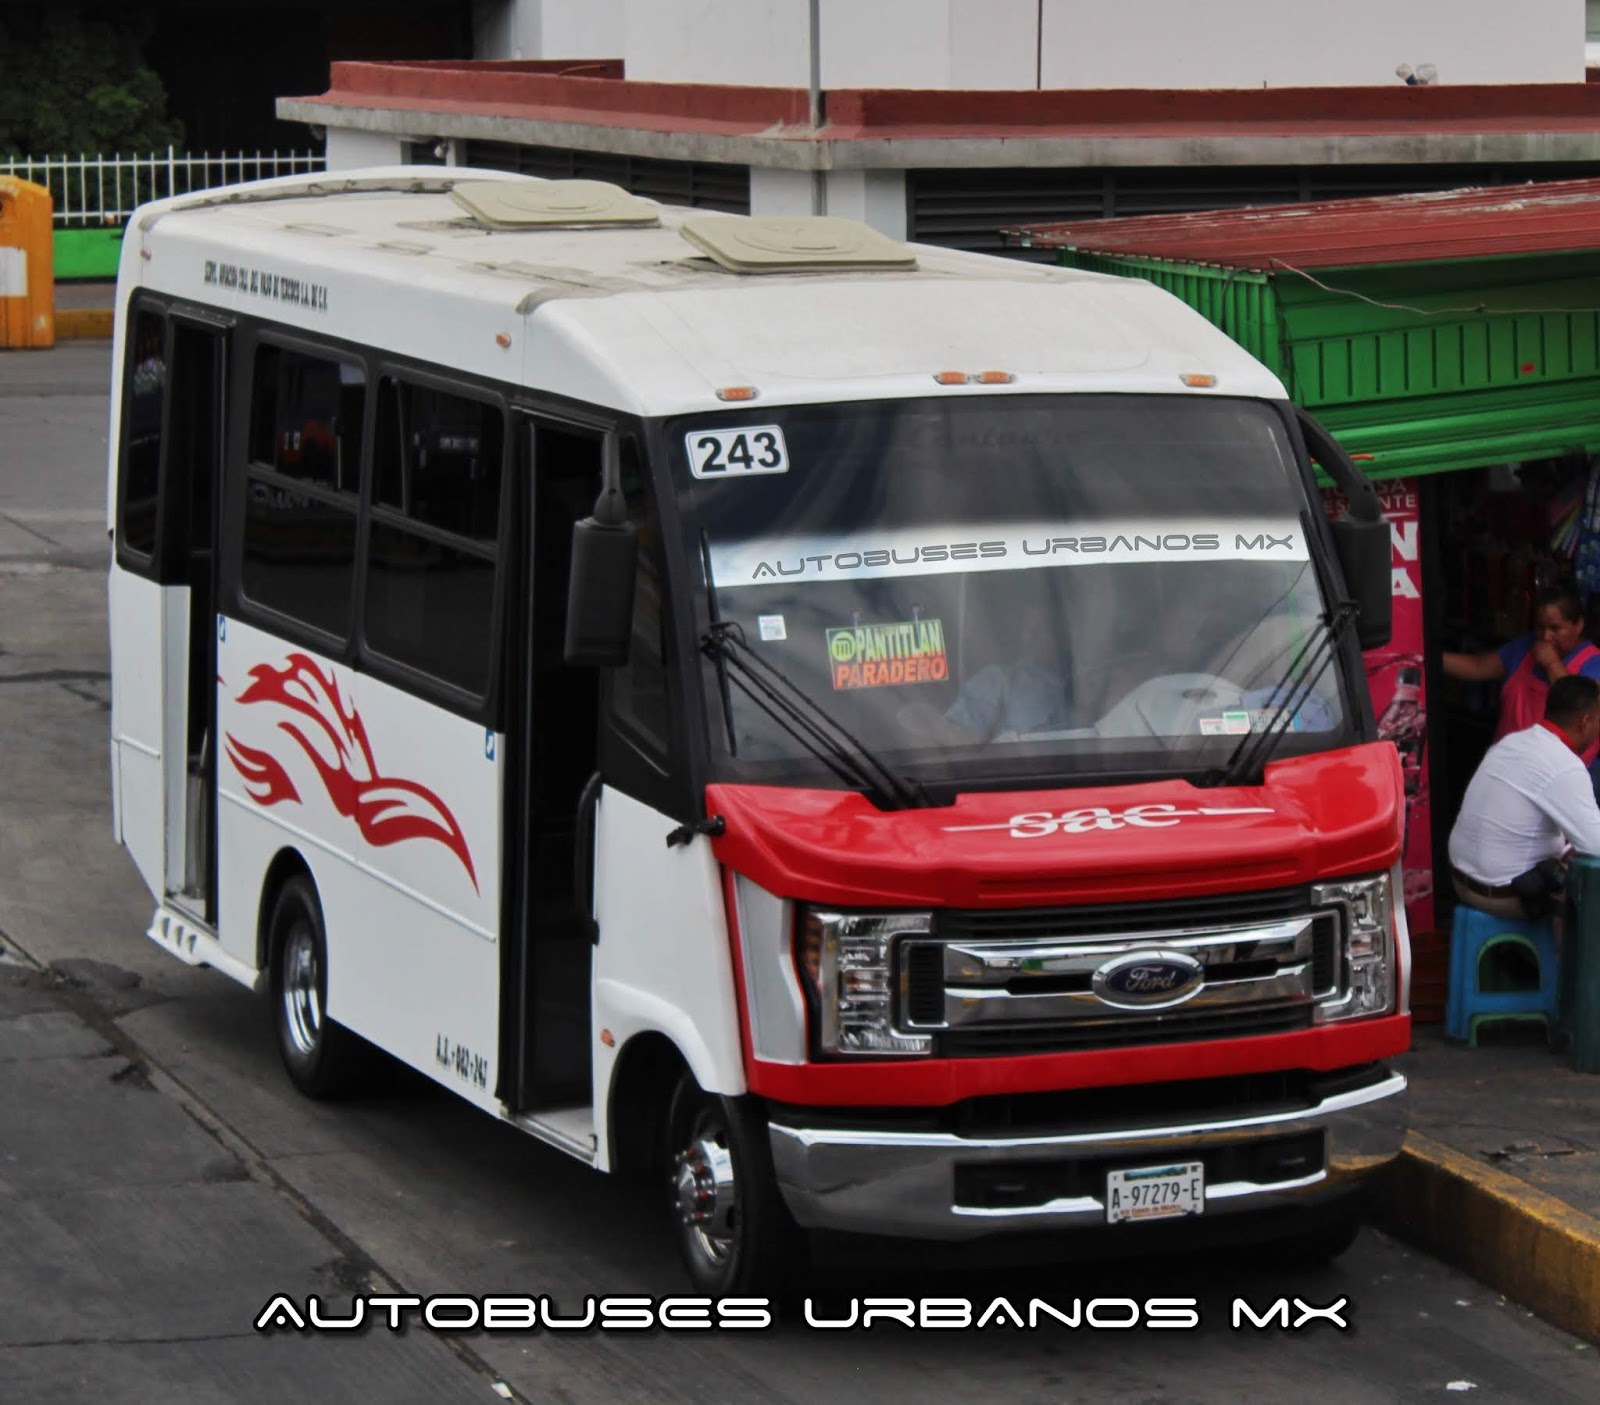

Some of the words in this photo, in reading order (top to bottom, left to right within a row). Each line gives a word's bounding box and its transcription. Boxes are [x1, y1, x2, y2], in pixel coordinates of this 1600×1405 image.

[697, 432, 782, 473] 243
[855, 620, 943, 664] PANTITLAN
[835, 656, 948, 690] PARADERO
[1125, 966, 1176, 992] Ford
[1112, 1178, 1201, 1210] A-97279-E
